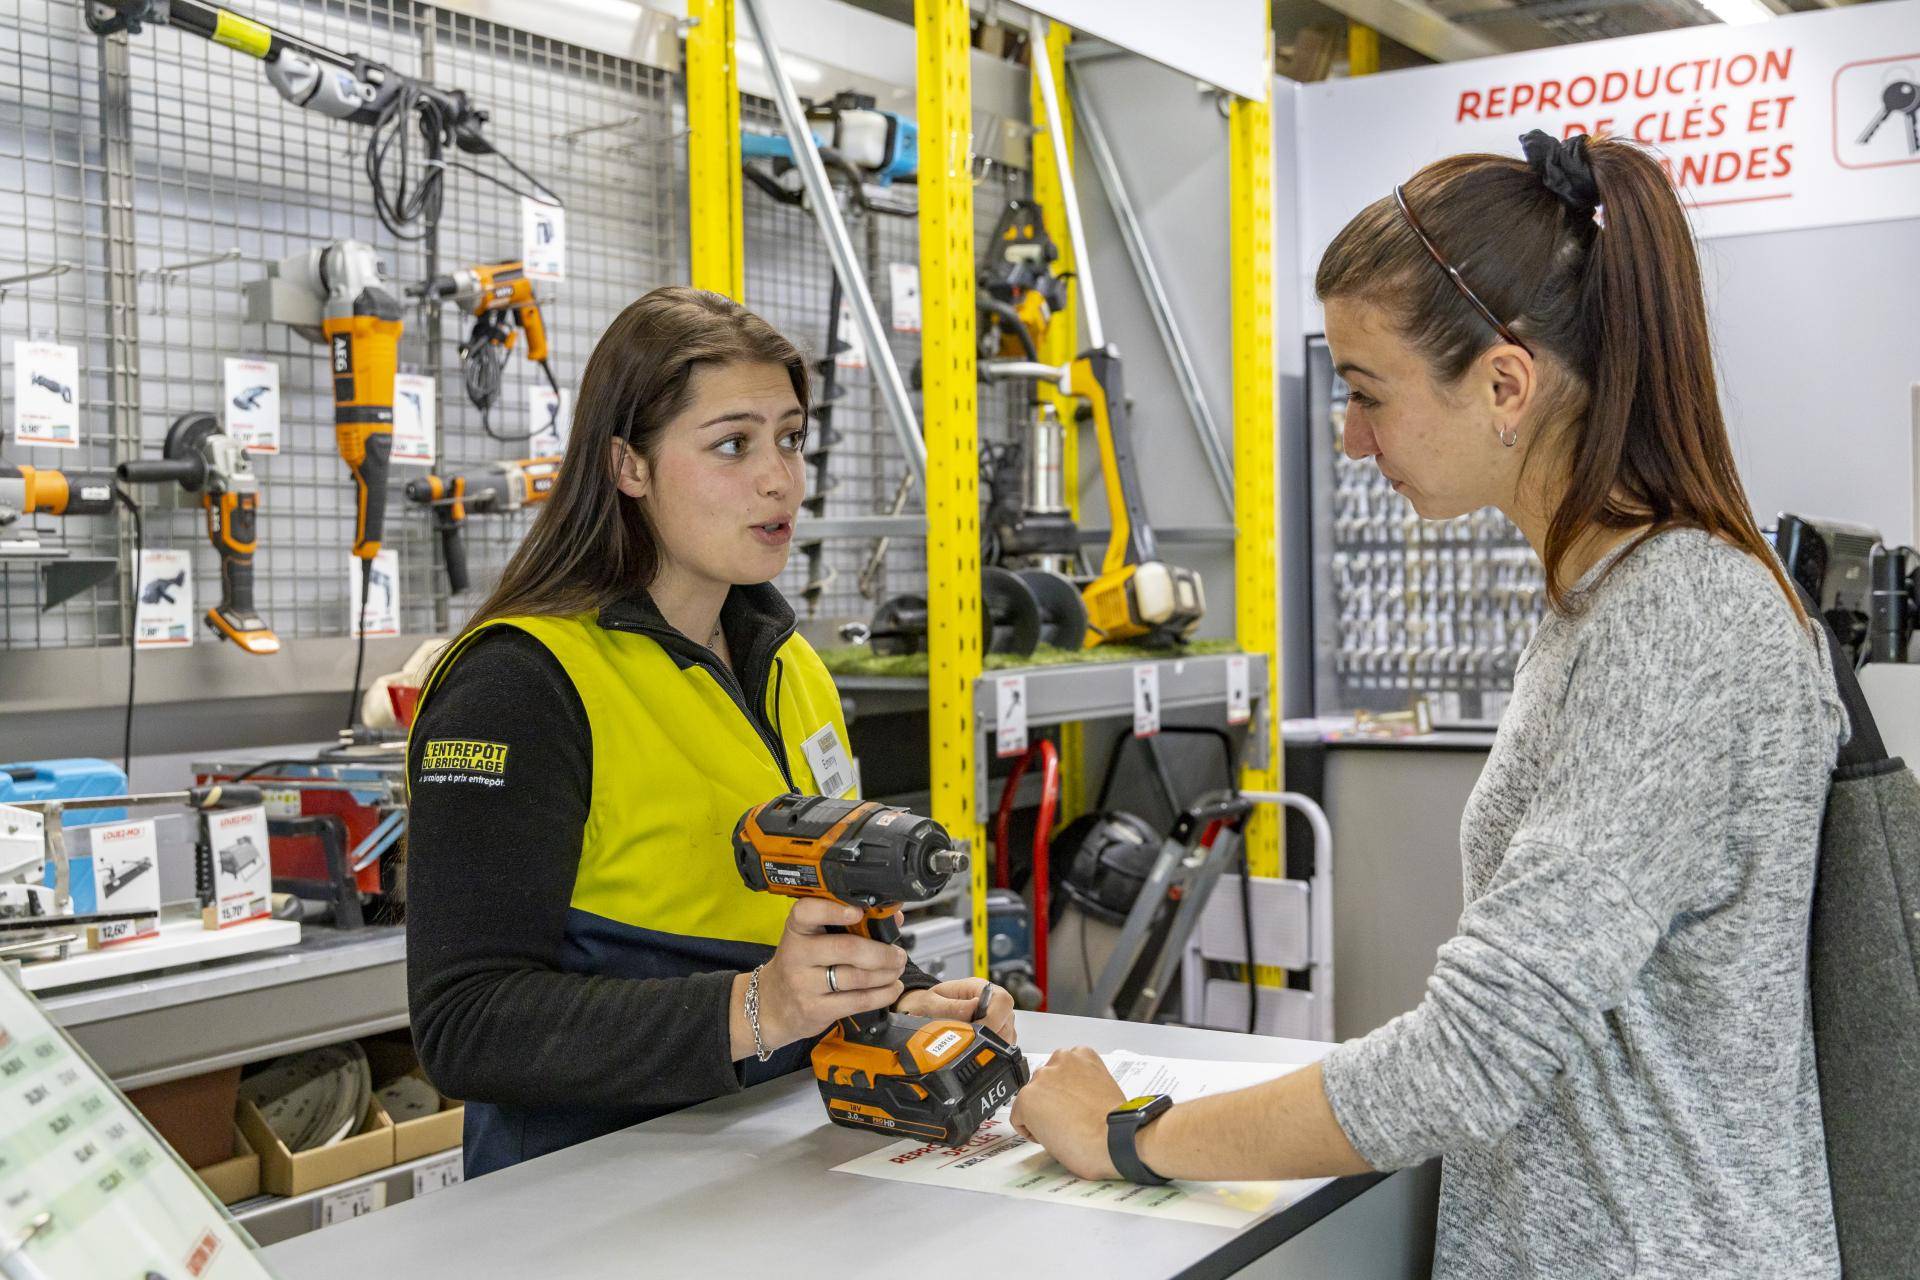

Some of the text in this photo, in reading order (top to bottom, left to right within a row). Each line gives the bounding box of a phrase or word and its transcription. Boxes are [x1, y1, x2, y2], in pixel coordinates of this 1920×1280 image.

[1457, 47, 1793, 122] REPRODUCTION
[1633, 99, 1728, 144] CLÉS
[1747, 96, 1795, 132] ET
[424, 742, 506, 760] L'ENTREPÔT
[435, 758, 502, 773] BRICOLAGE
[454, 773, 467, 784] prix
[980, 1080, 1007, 1114] AEG
